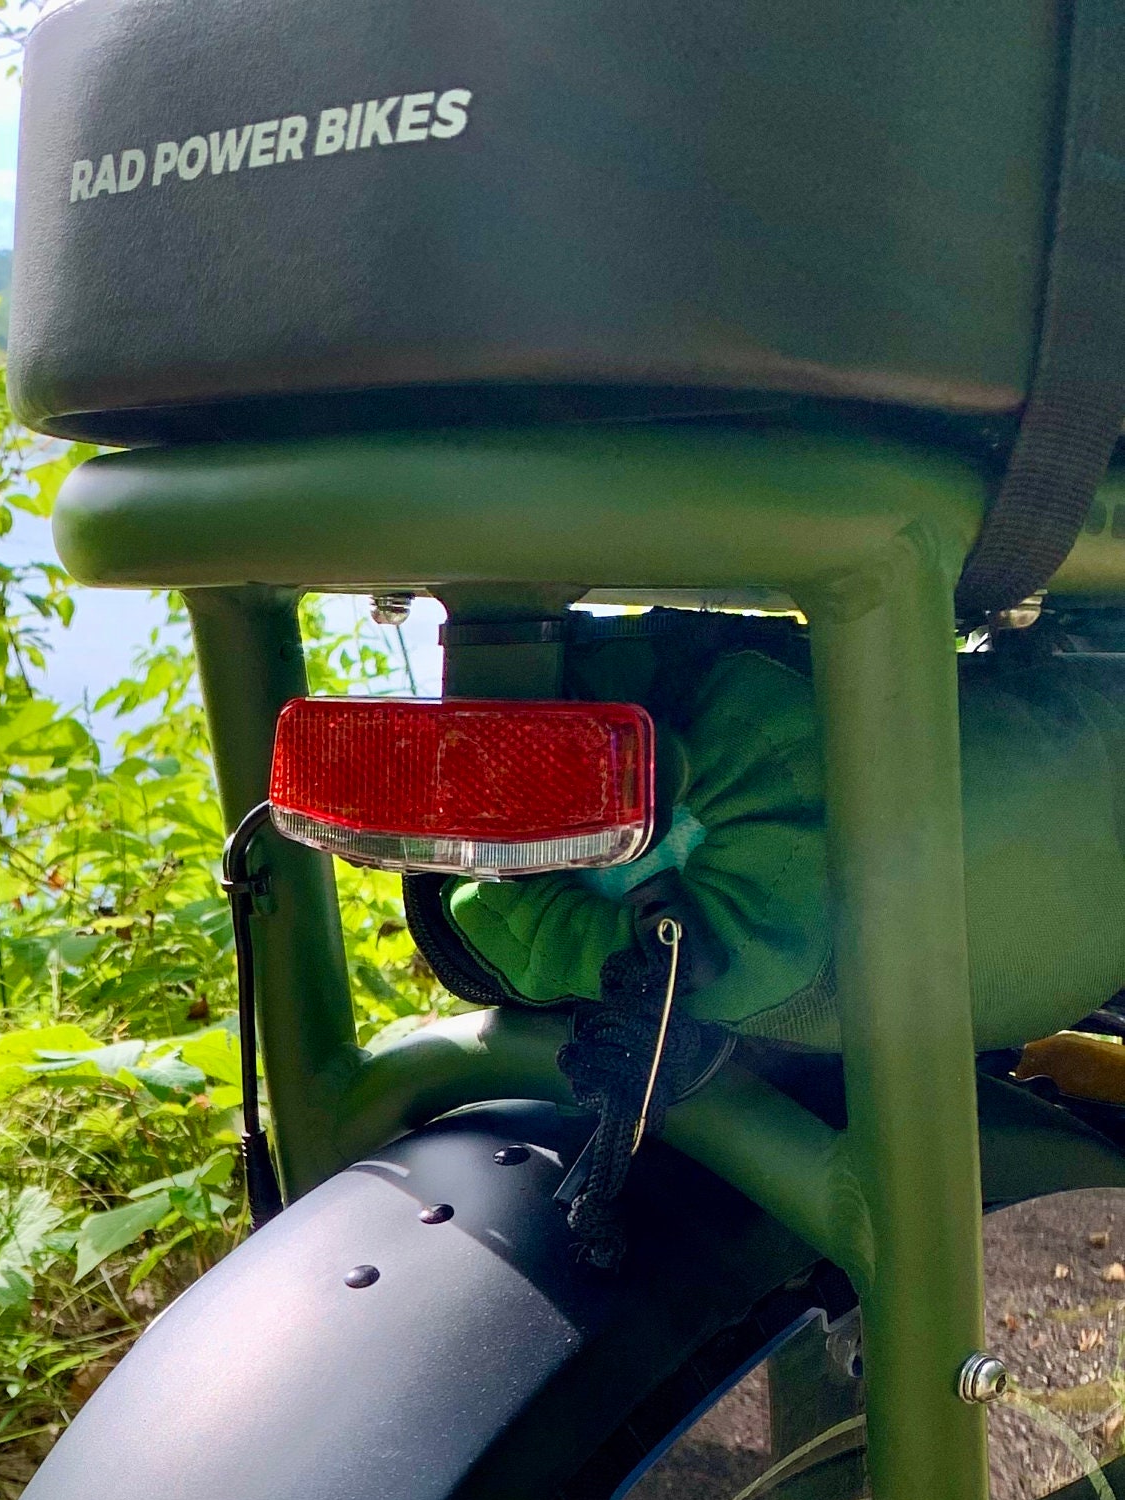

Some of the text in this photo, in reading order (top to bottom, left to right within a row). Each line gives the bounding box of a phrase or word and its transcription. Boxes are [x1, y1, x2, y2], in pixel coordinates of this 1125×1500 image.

[70, 88, 472, 202] RAD POWER BIKES
